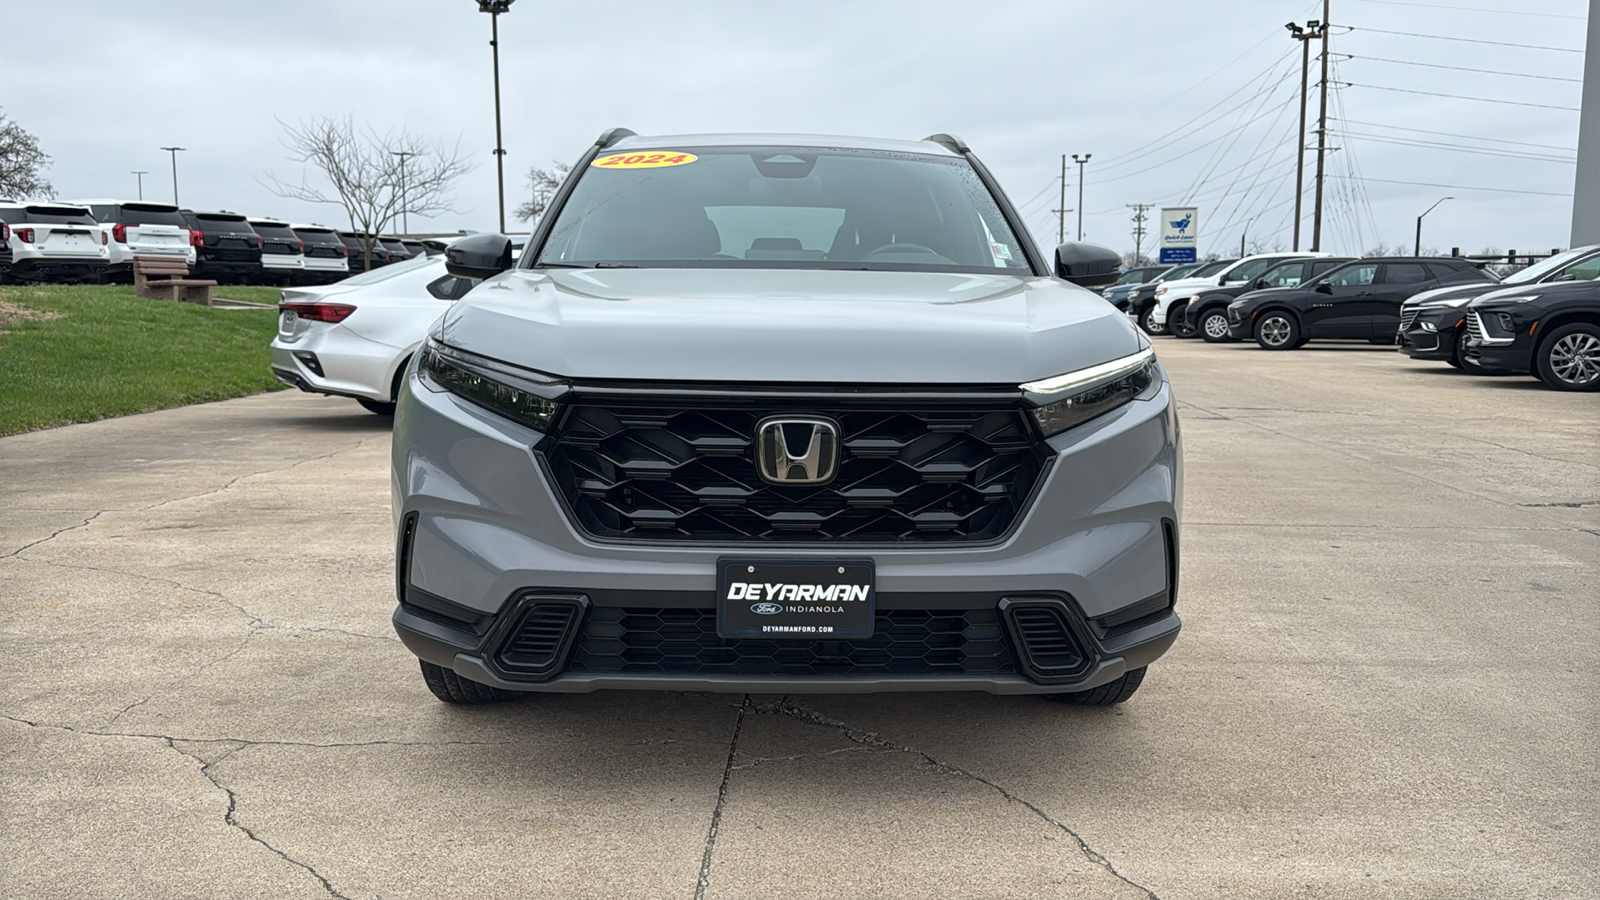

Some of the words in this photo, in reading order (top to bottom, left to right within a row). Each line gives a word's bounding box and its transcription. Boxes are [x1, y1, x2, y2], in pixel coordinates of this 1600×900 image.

[600, 154, 688, 166] 2024
[726, 582, 870, 602] DEYARMAN
[756, 604, 777, 613] Ford
[785, 605, 845, 613] INDIANOLA
[762, 625, 834, 633] DEYARMANFORD.COM
